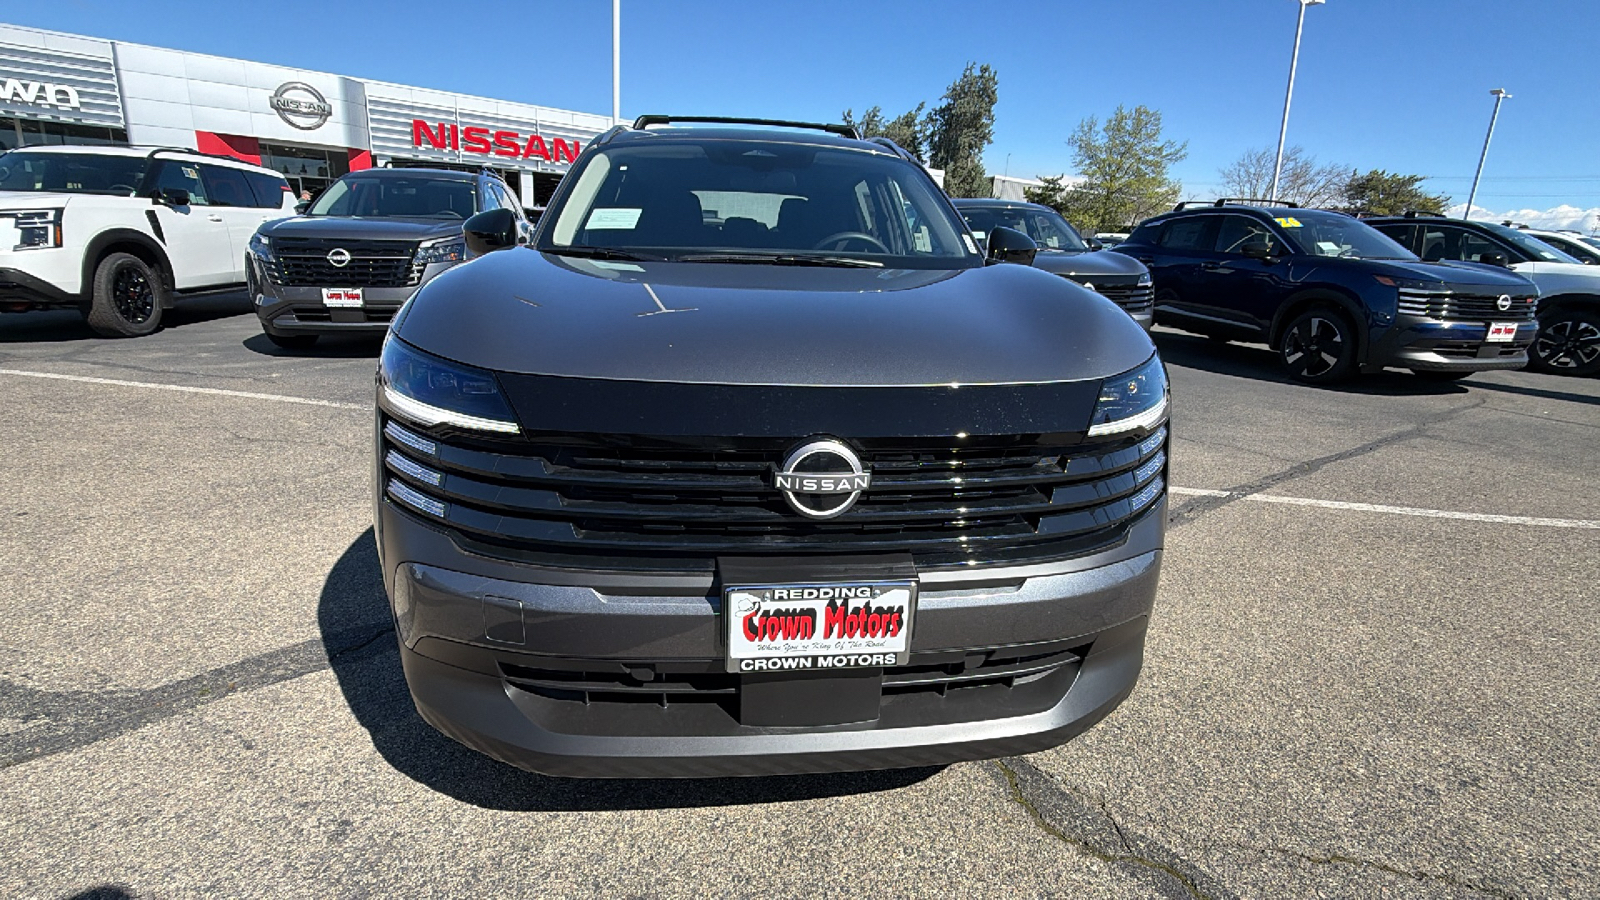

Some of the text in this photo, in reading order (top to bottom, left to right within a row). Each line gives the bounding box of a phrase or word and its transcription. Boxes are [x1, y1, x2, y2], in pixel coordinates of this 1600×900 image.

[276, 99, 326, 112] NISSAN
[412, 119, 580, 163] NISSAN
[776, 476, 868, 491] NISSAN
[774, 587, 872, 600] REDDING
[742, 603, 901, 642] Crown Motors
[757, 643, 781, 651] Where
[812, 642, 831, 651] King
[848, 640, 862, 649] The
[865, 640, 886, 648] Road
[740, 653, 896, 671] CROWN MOTORS
